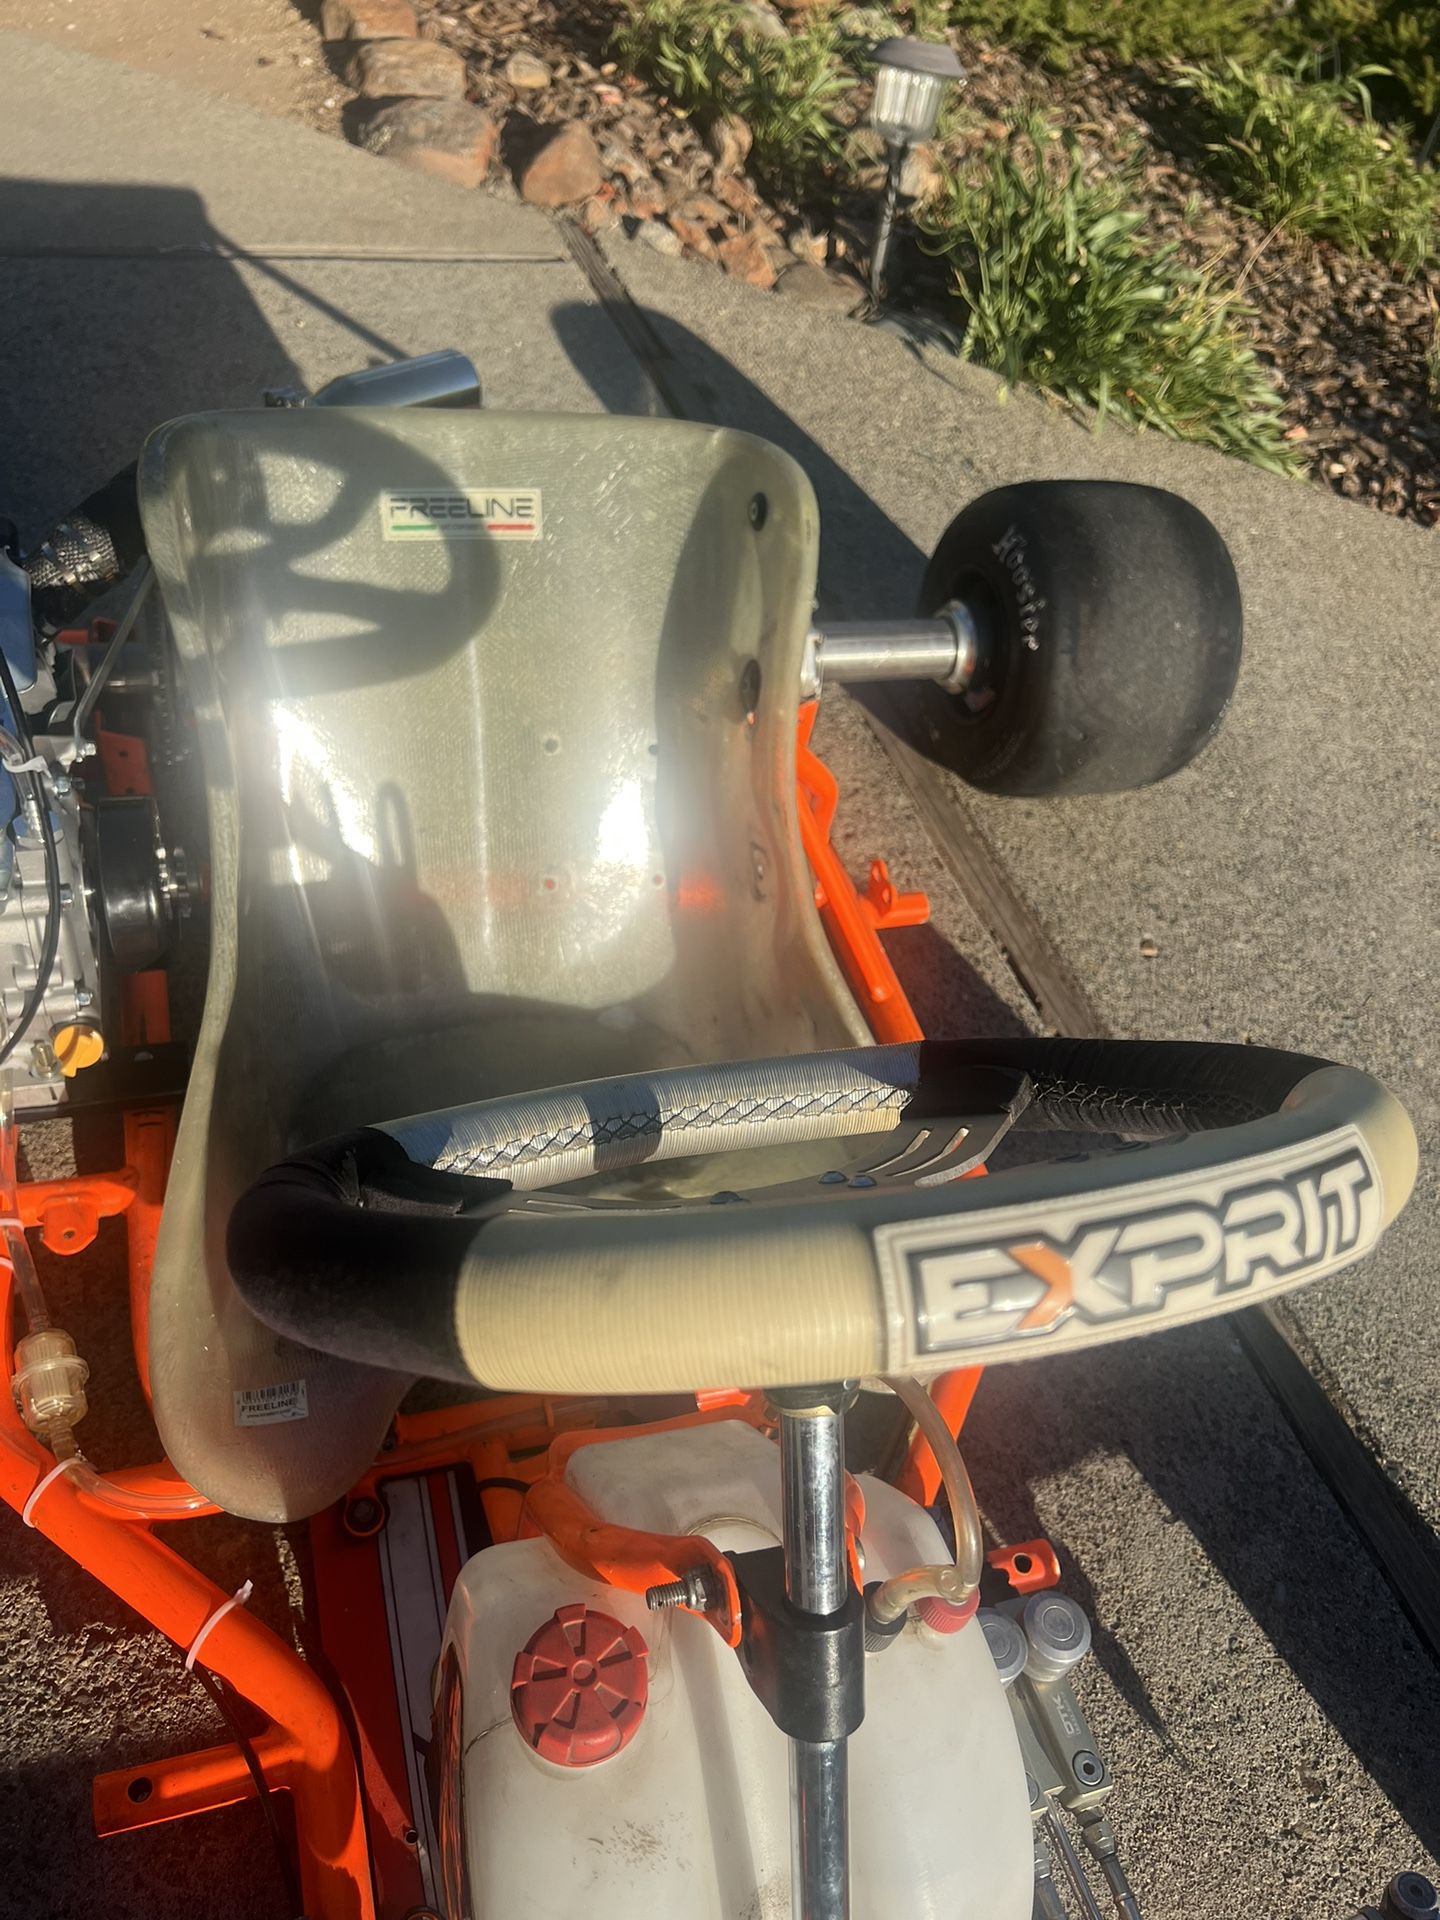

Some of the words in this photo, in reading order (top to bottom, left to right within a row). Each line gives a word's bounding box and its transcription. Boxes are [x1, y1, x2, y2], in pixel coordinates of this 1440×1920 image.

[390, 497, 534, 518] FREELINE
[911, 1150, 1370, 1354] EXPRIT
[241, 1397, 297, 1412] FREELINE
[1052, 1695, 1075, 1736] OTK
